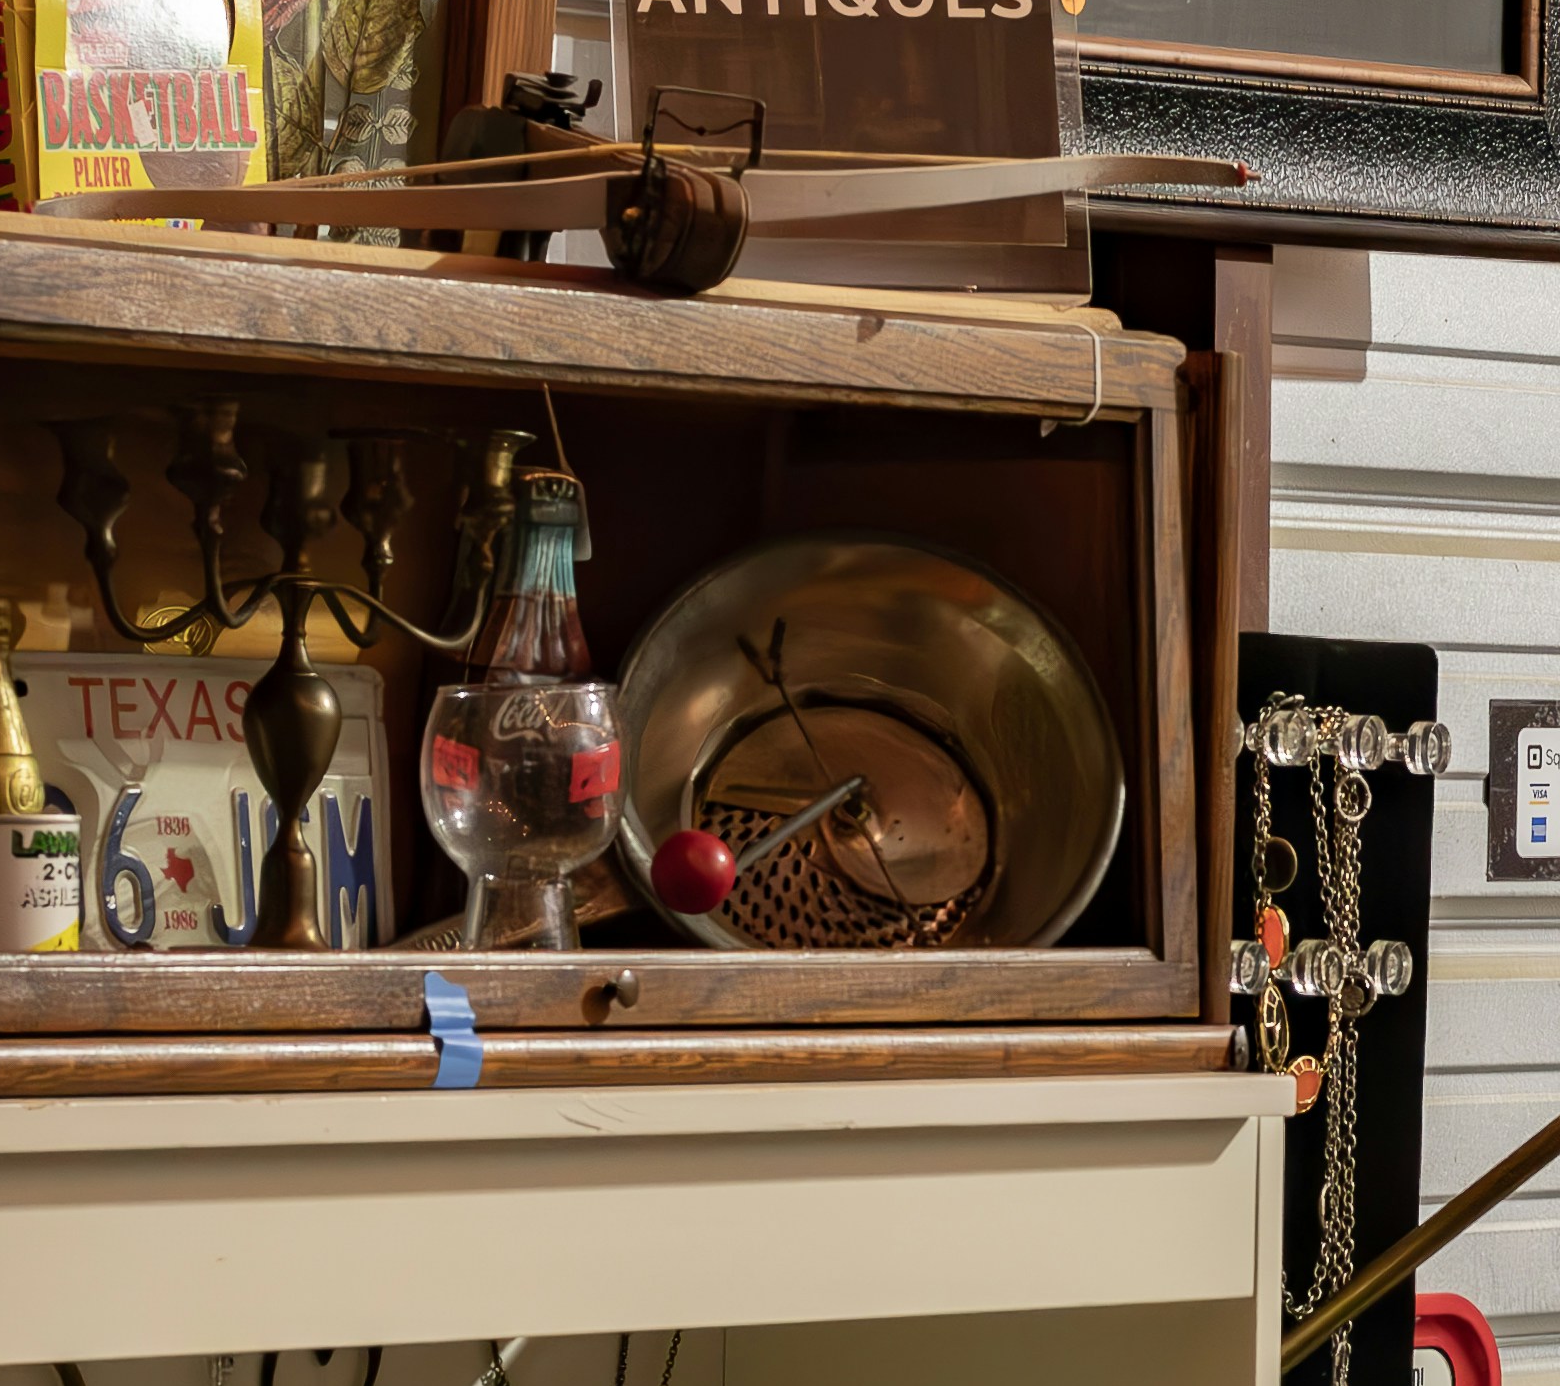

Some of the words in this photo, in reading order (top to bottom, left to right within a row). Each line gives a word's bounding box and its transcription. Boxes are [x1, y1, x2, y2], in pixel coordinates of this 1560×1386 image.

[37, 66, 259, 155] BASKETBALL
[72, 155, 134, 190] PLAYER
[68, 676, 251, 744] TEXAS
[1531, 786, 1549, 801] VISA
[155, 815, 192, 838] 1836
[162, 908, 200, 932] 1986
